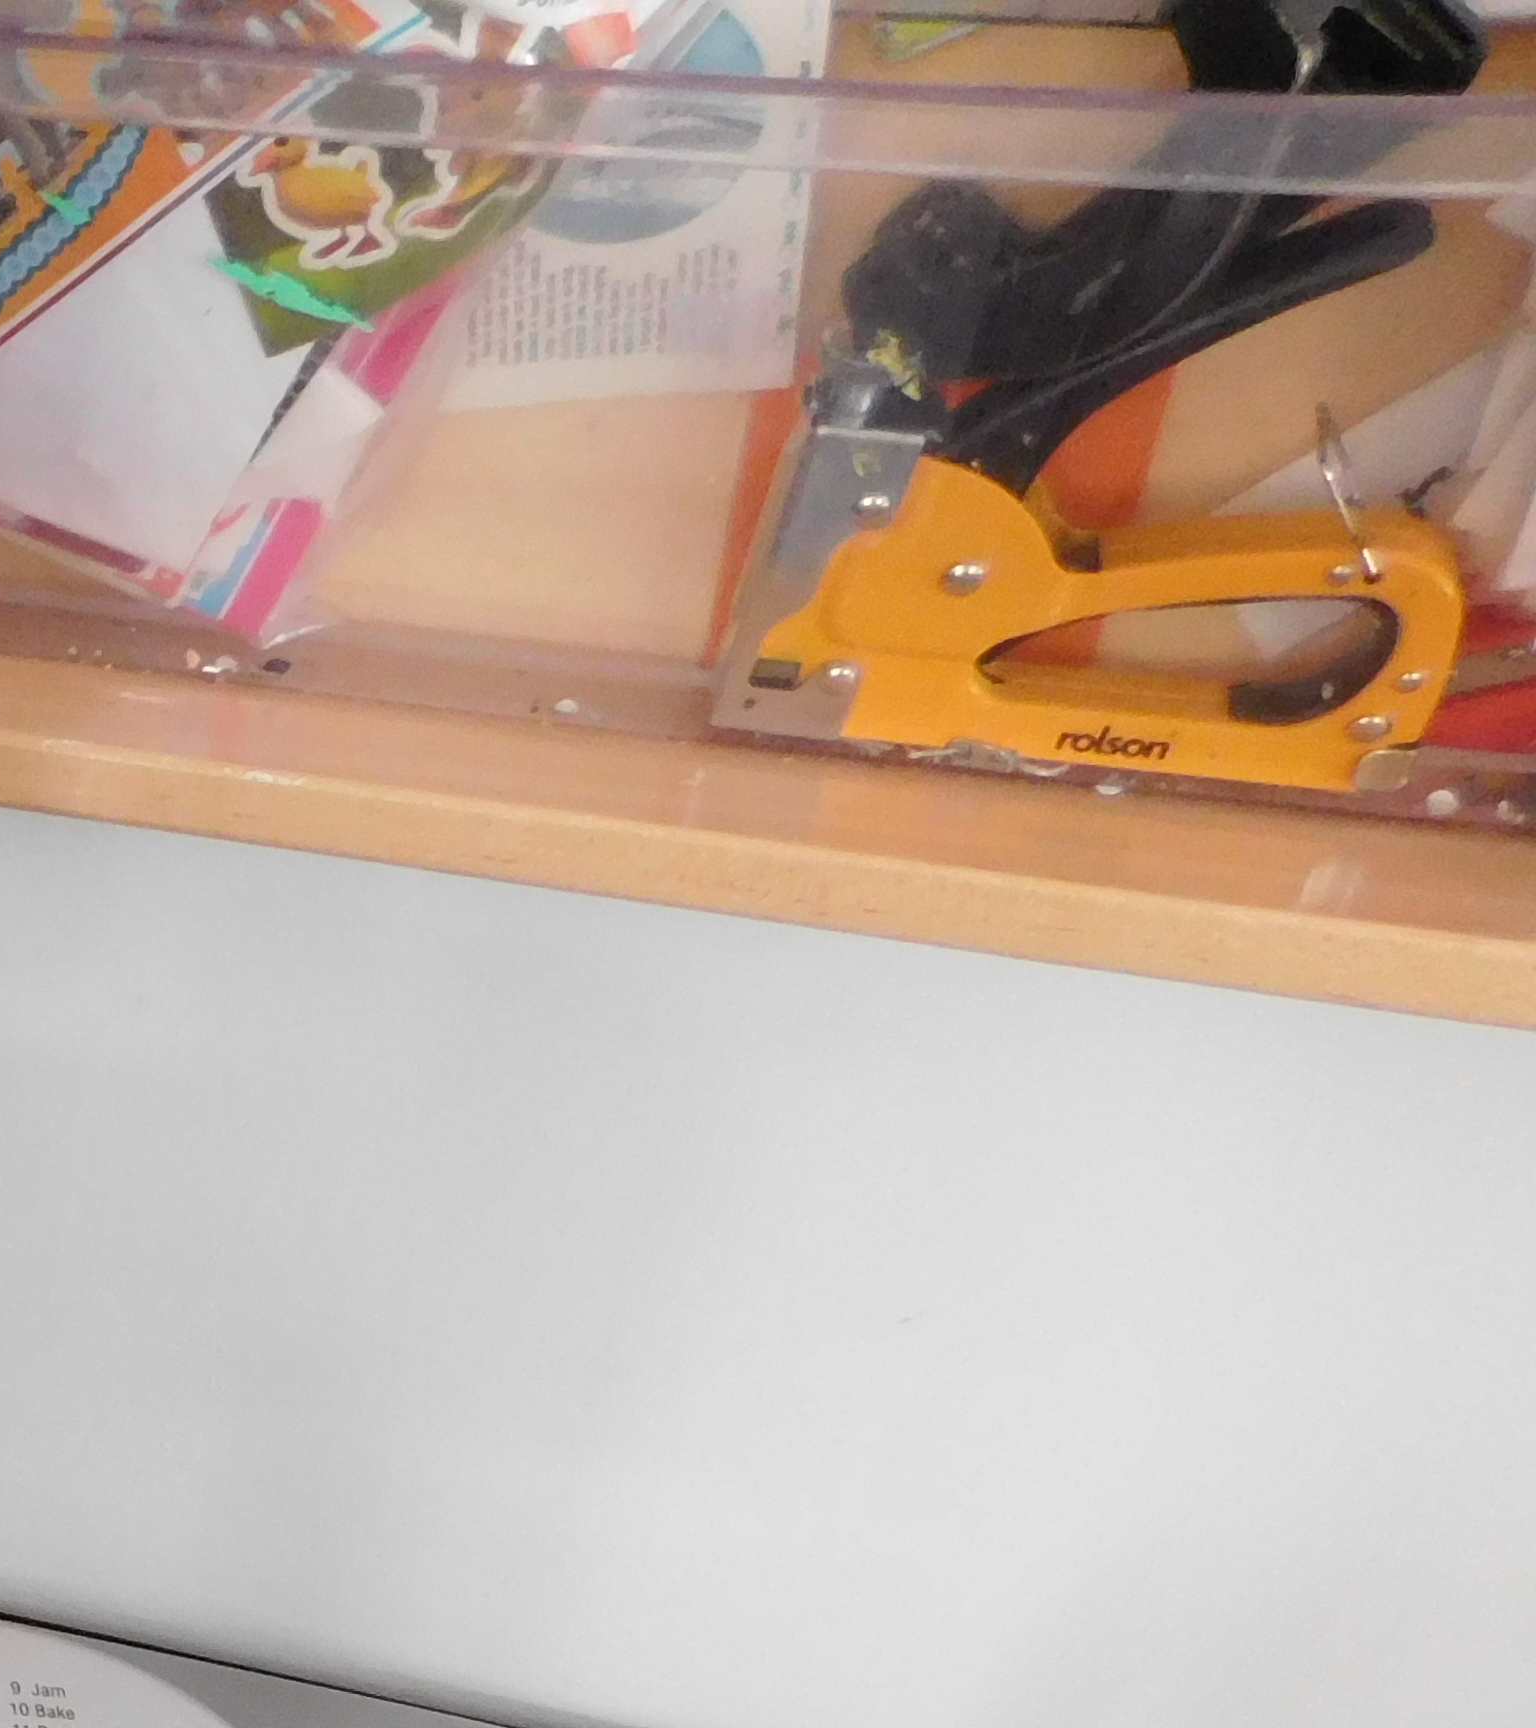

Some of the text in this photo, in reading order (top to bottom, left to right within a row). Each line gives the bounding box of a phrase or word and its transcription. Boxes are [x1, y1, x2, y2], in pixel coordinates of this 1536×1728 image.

[1055, 725, 1170, 760] rolson
[10, 1681, 66, 1698] 9 Jam
[10, 1703, 75, 1720] 10 Bake
